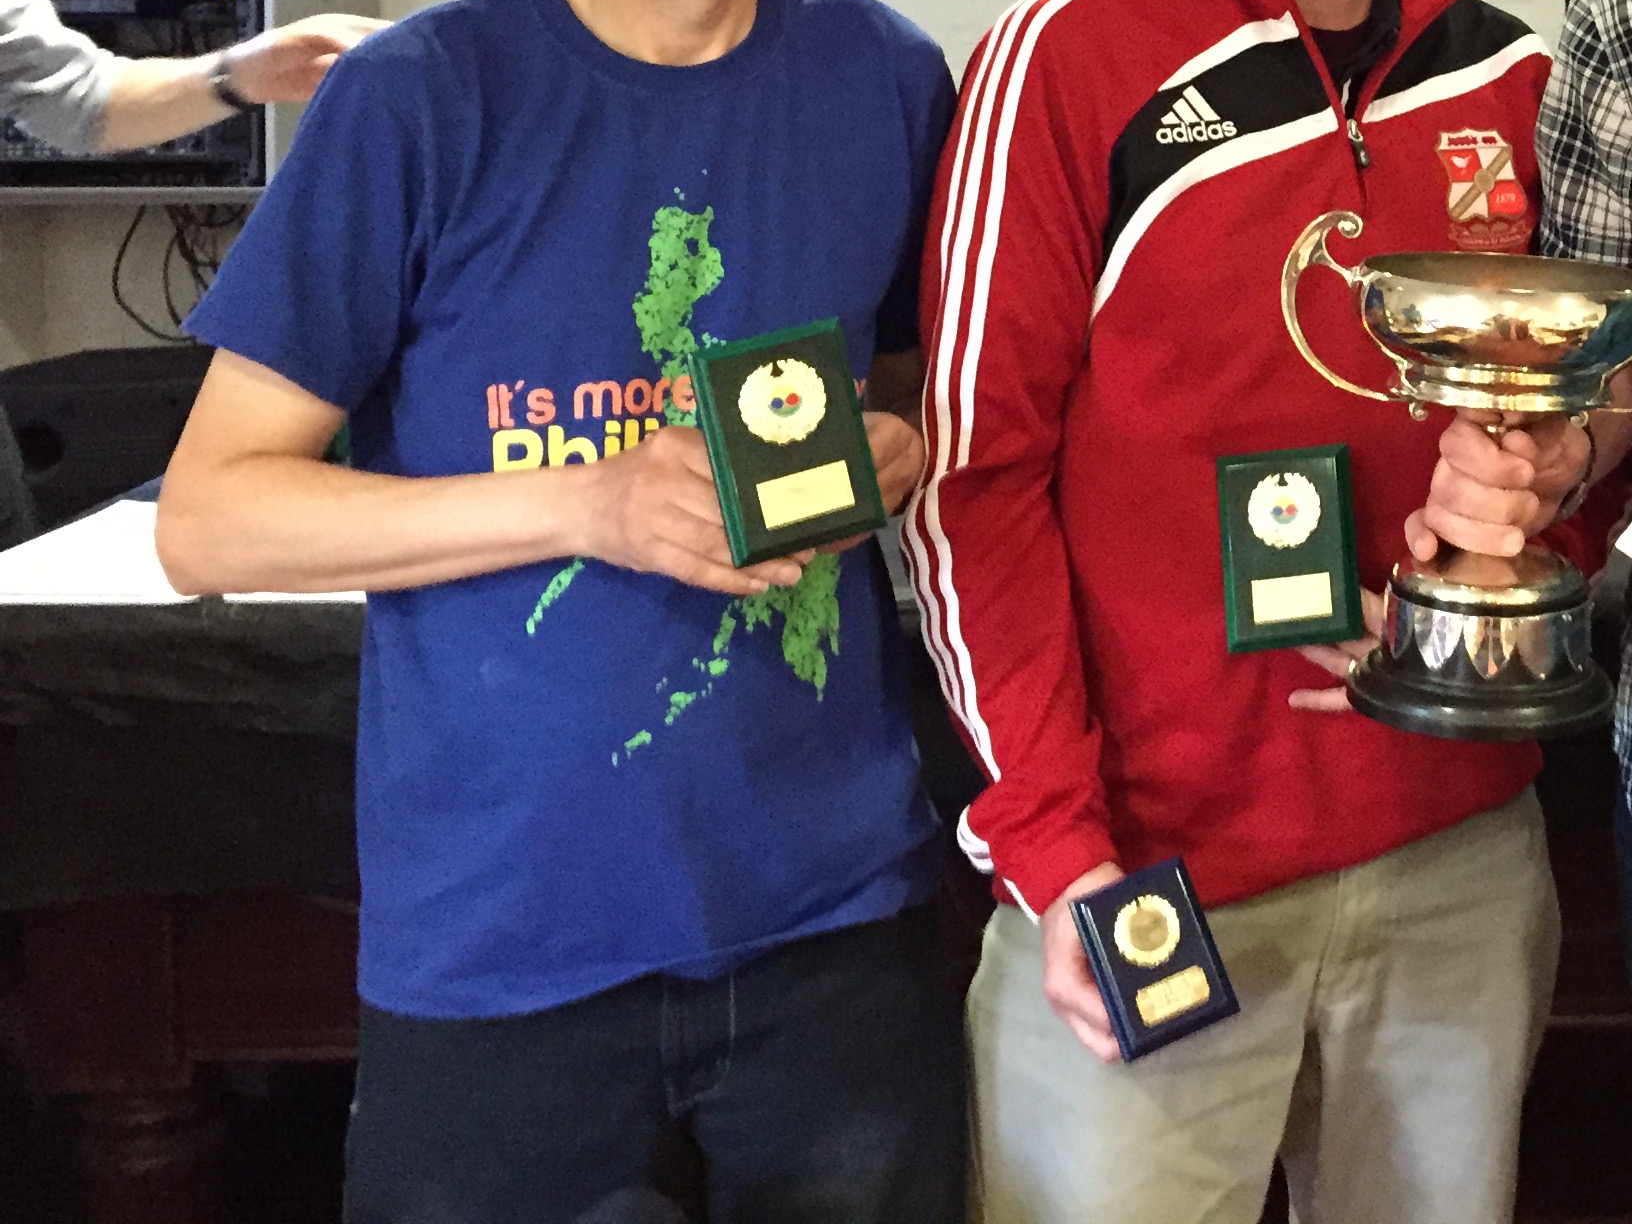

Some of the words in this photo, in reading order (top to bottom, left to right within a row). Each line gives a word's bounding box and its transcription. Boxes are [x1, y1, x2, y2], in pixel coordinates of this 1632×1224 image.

[1155, 120, 1237, 144] adidas
[486, 379, 557, 429] It's
[573, 375, 697, 420] more
